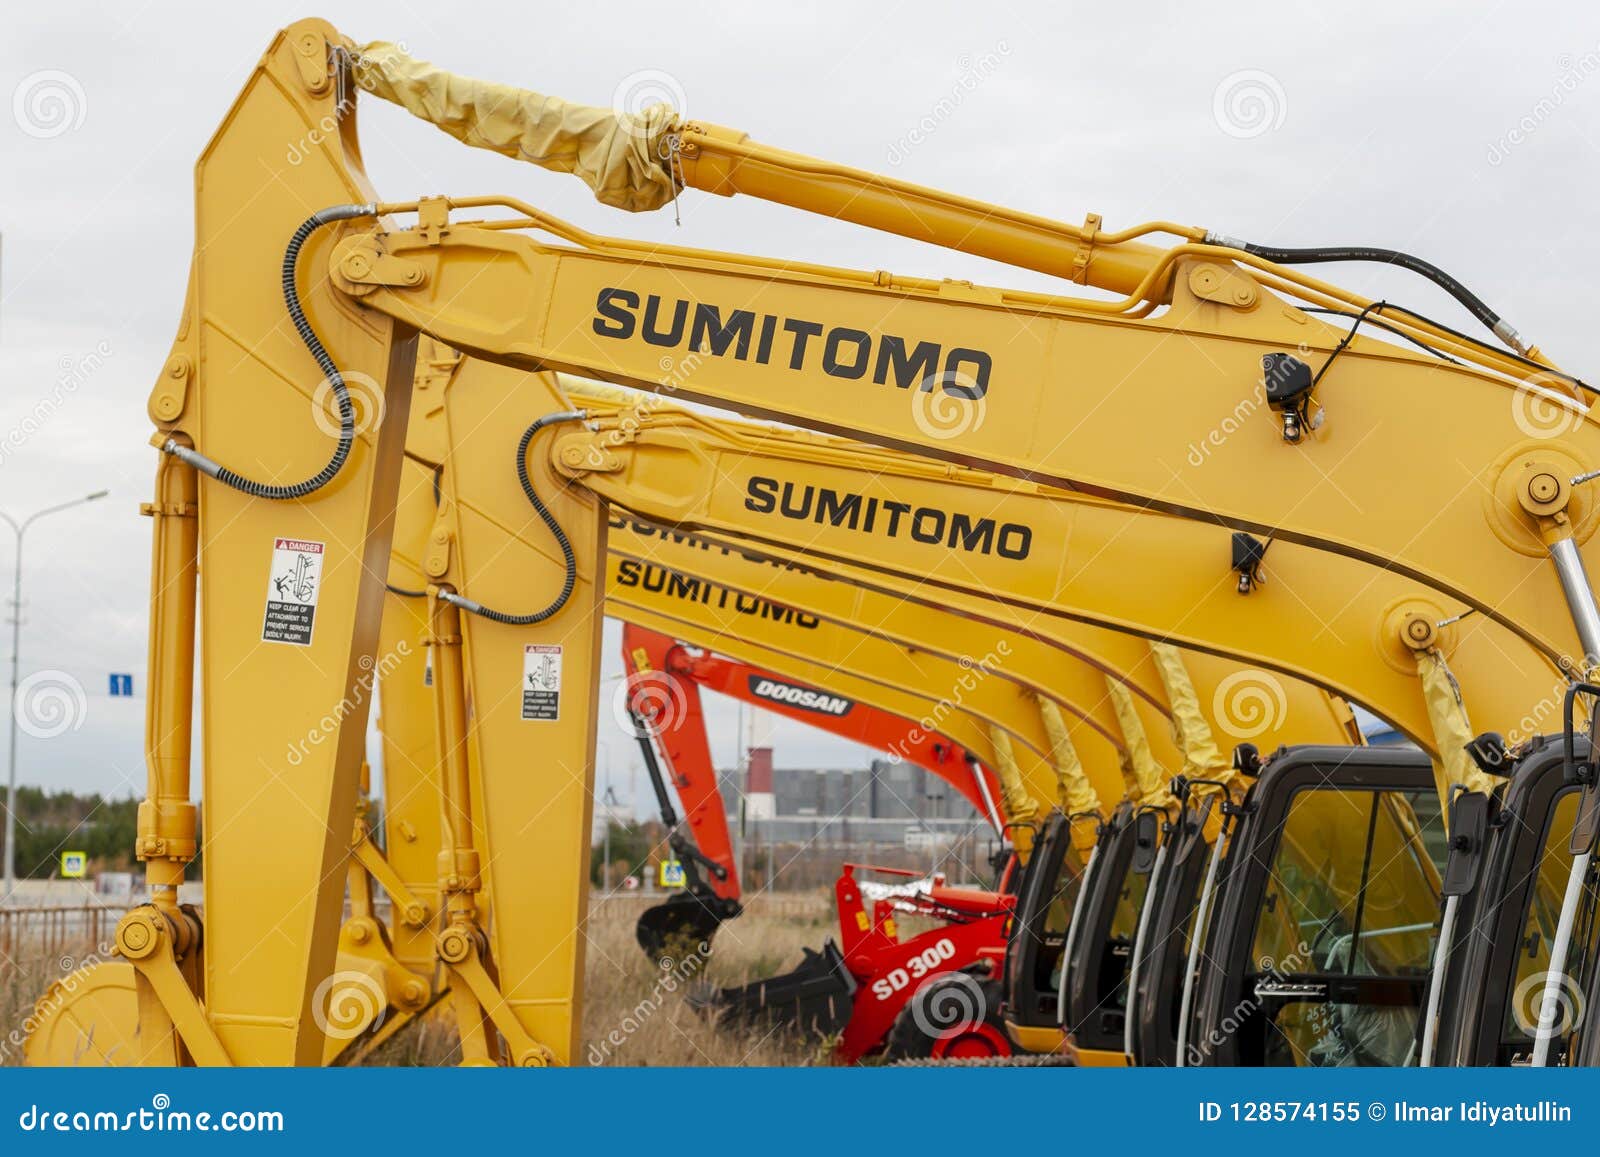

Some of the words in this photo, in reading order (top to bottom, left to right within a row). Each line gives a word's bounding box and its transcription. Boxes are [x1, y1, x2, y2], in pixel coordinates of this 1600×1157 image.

[592, 287, 993, 401] SUMITOMO
[744, 476, 1032, 560] SUMITOMO
[288, 542, 320, 552] DANGER
[267, 613, 300, 622] ATTACHMENT
[283, 604, 299, 612] CLEAR
[266, 622, 288, 630] PREVENT
[755, 680, 848, 715] DOOSAN
[872, 967, 910, 1001] SD
[906, 938, 956, 979] 300
